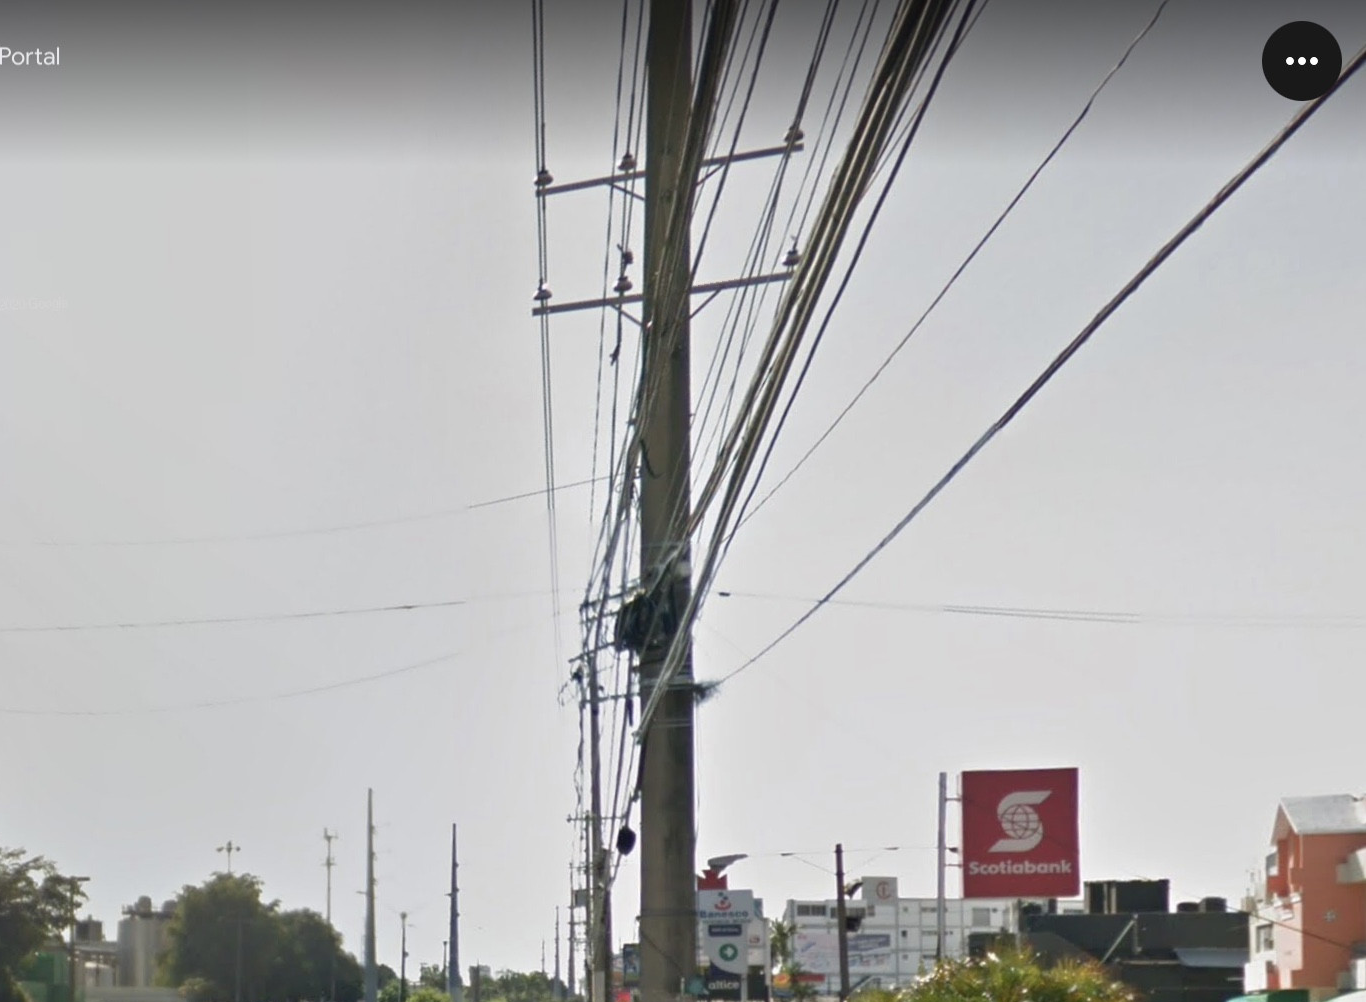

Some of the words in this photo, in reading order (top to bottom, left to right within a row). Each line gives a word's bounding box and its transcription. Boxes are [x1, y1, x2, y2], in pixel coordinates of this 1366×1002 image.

[969, 859, 1072, 876] Scotiabank
[700, 910, 749, 919] Banesco
[708, 979, 740, 990] altice
